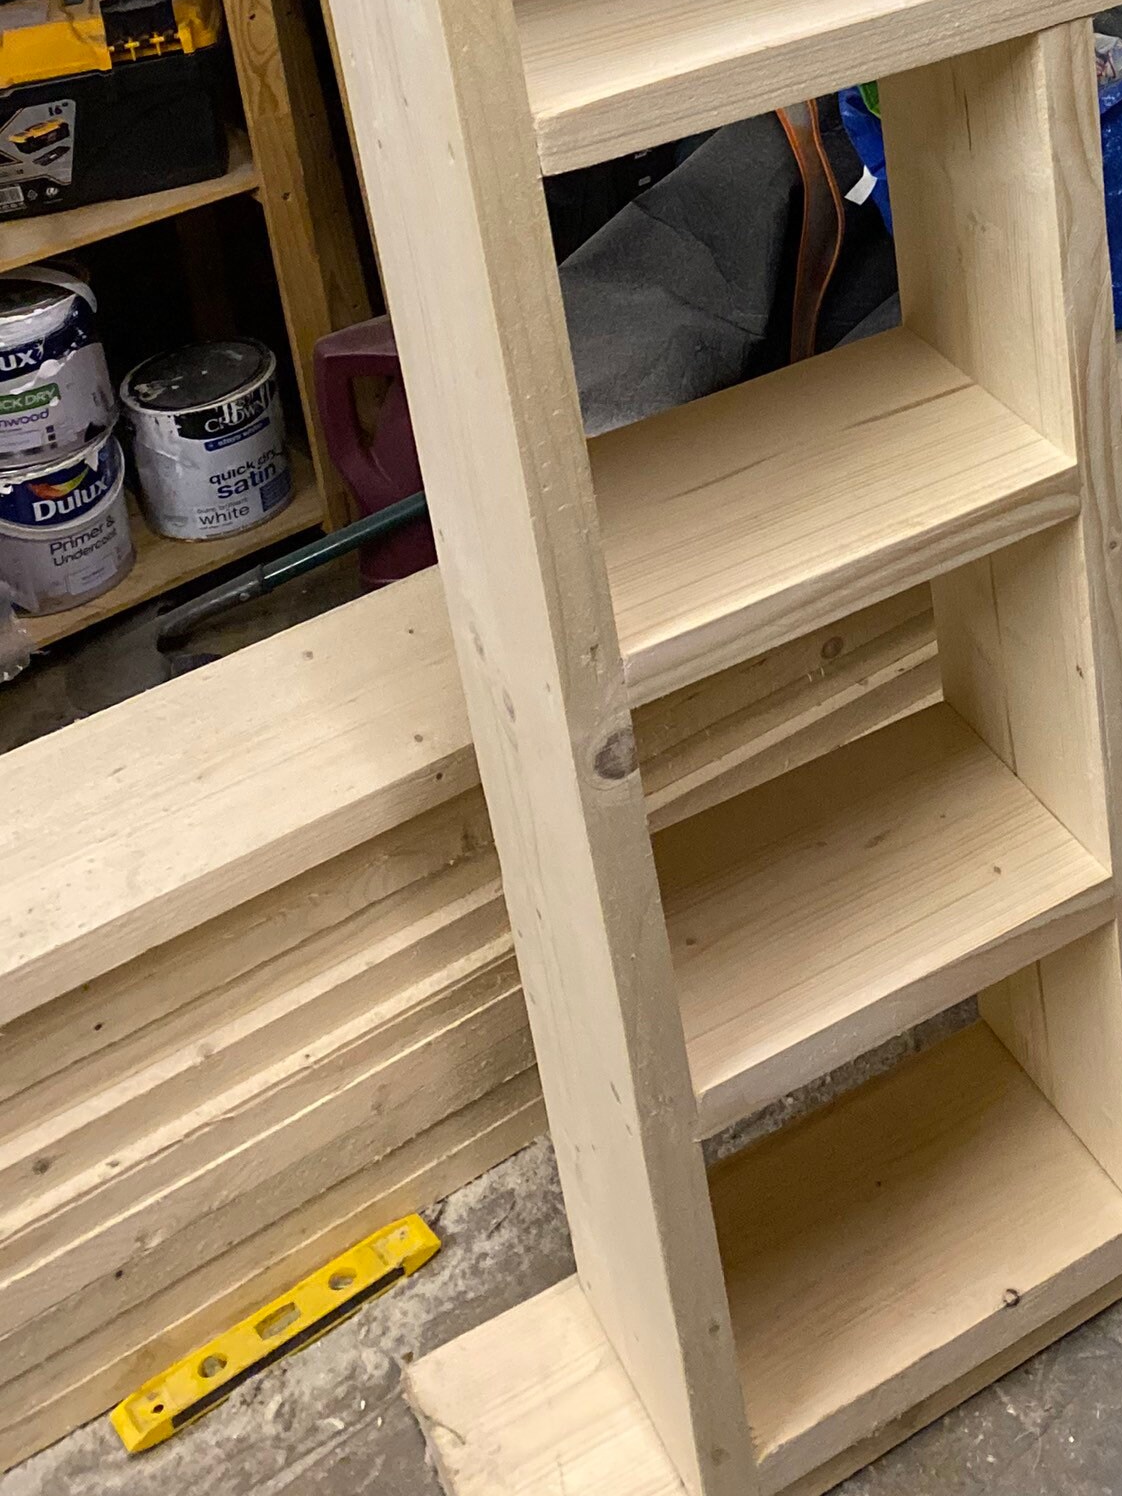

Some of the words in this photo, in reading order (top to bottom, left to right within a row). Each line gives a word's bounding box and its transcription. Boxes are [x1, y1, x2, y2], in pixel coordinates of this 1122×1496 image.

[0, 408, 49, 428] nwood
[209, 461, 255, 485] quick
[217, 463, 276, 499] satin
[32, 476, 108, 522] Dulux
[199, 506, 250, 525] white
[49, 524, 103, 555] Primer
[106, 515, 115, 528] &
[53, 528, 118, 566] Undercoat
